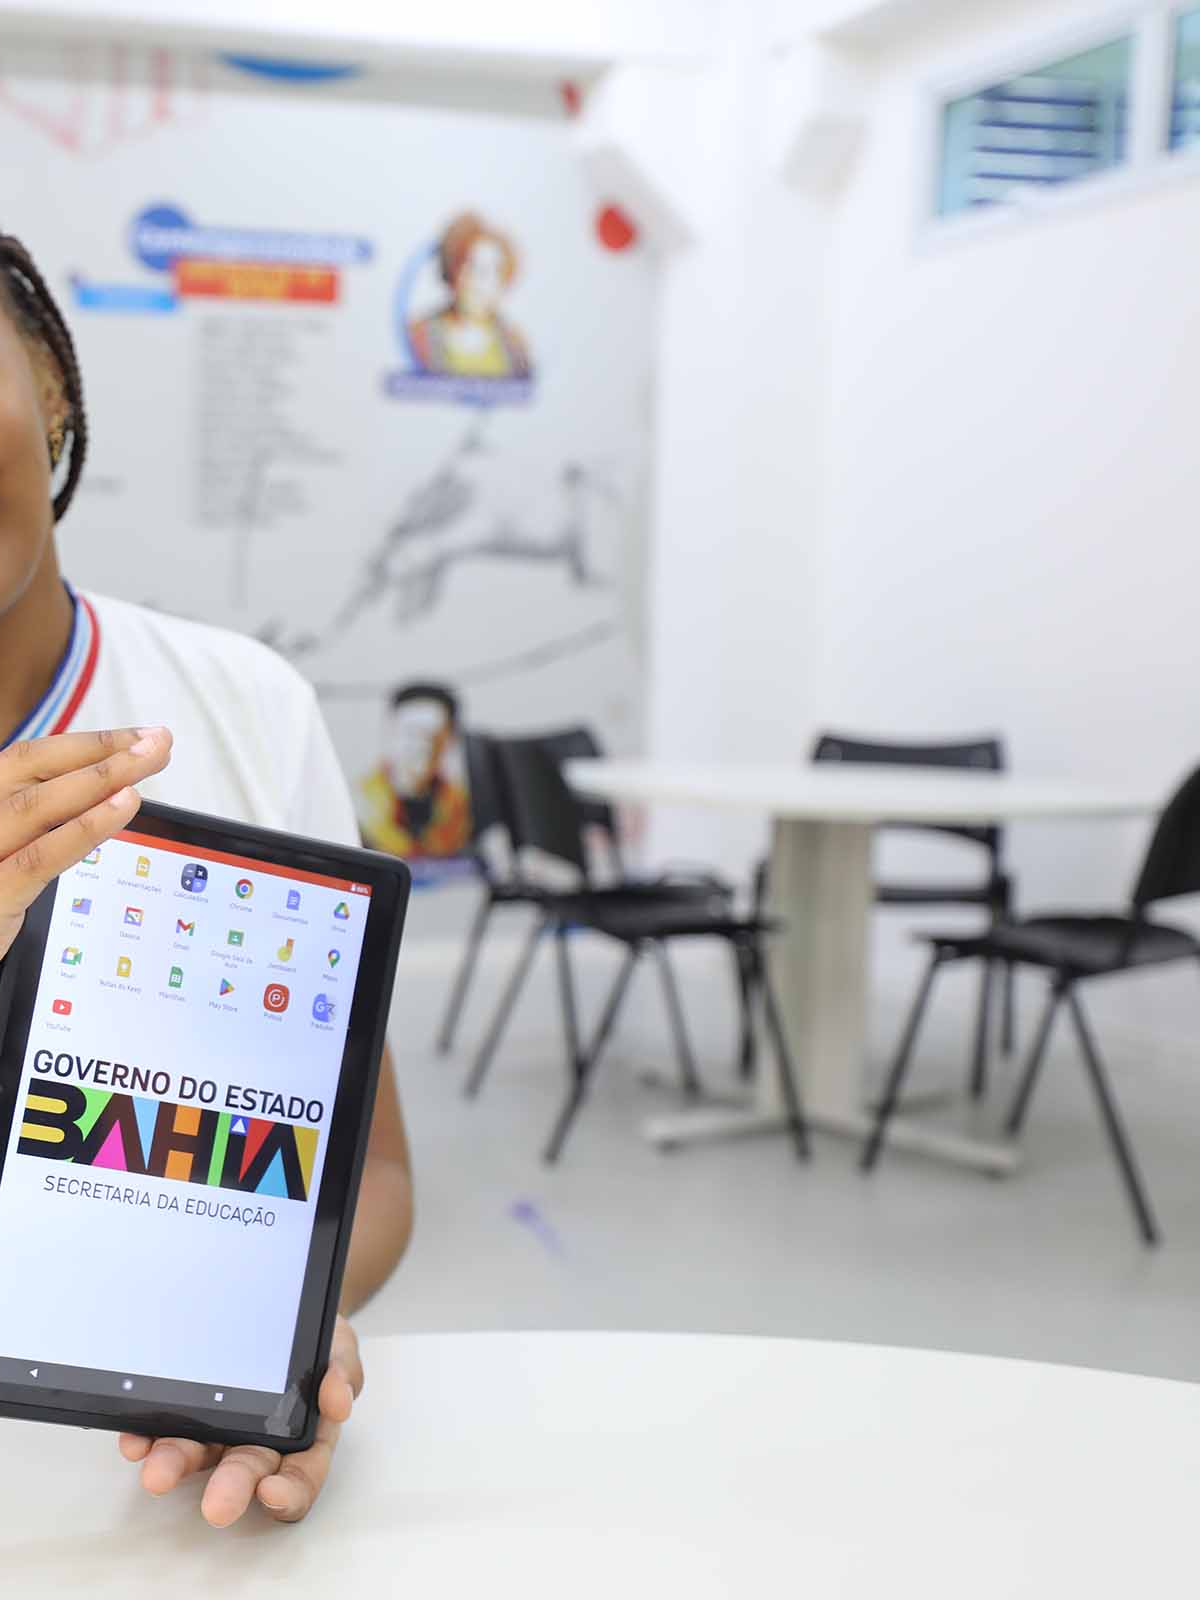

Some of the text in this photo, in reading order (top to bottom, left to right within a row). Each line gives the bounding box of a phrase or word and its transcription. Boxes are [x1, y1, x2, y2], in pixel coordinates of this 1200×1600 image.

[33, 1049, 324, 1123] GOVERNO DO ESTADO
[17, 1078, 308, 1202] BAHIA
[44, 1175, 275, 1227] SECRETARIA DA EDUCAÇÃO
